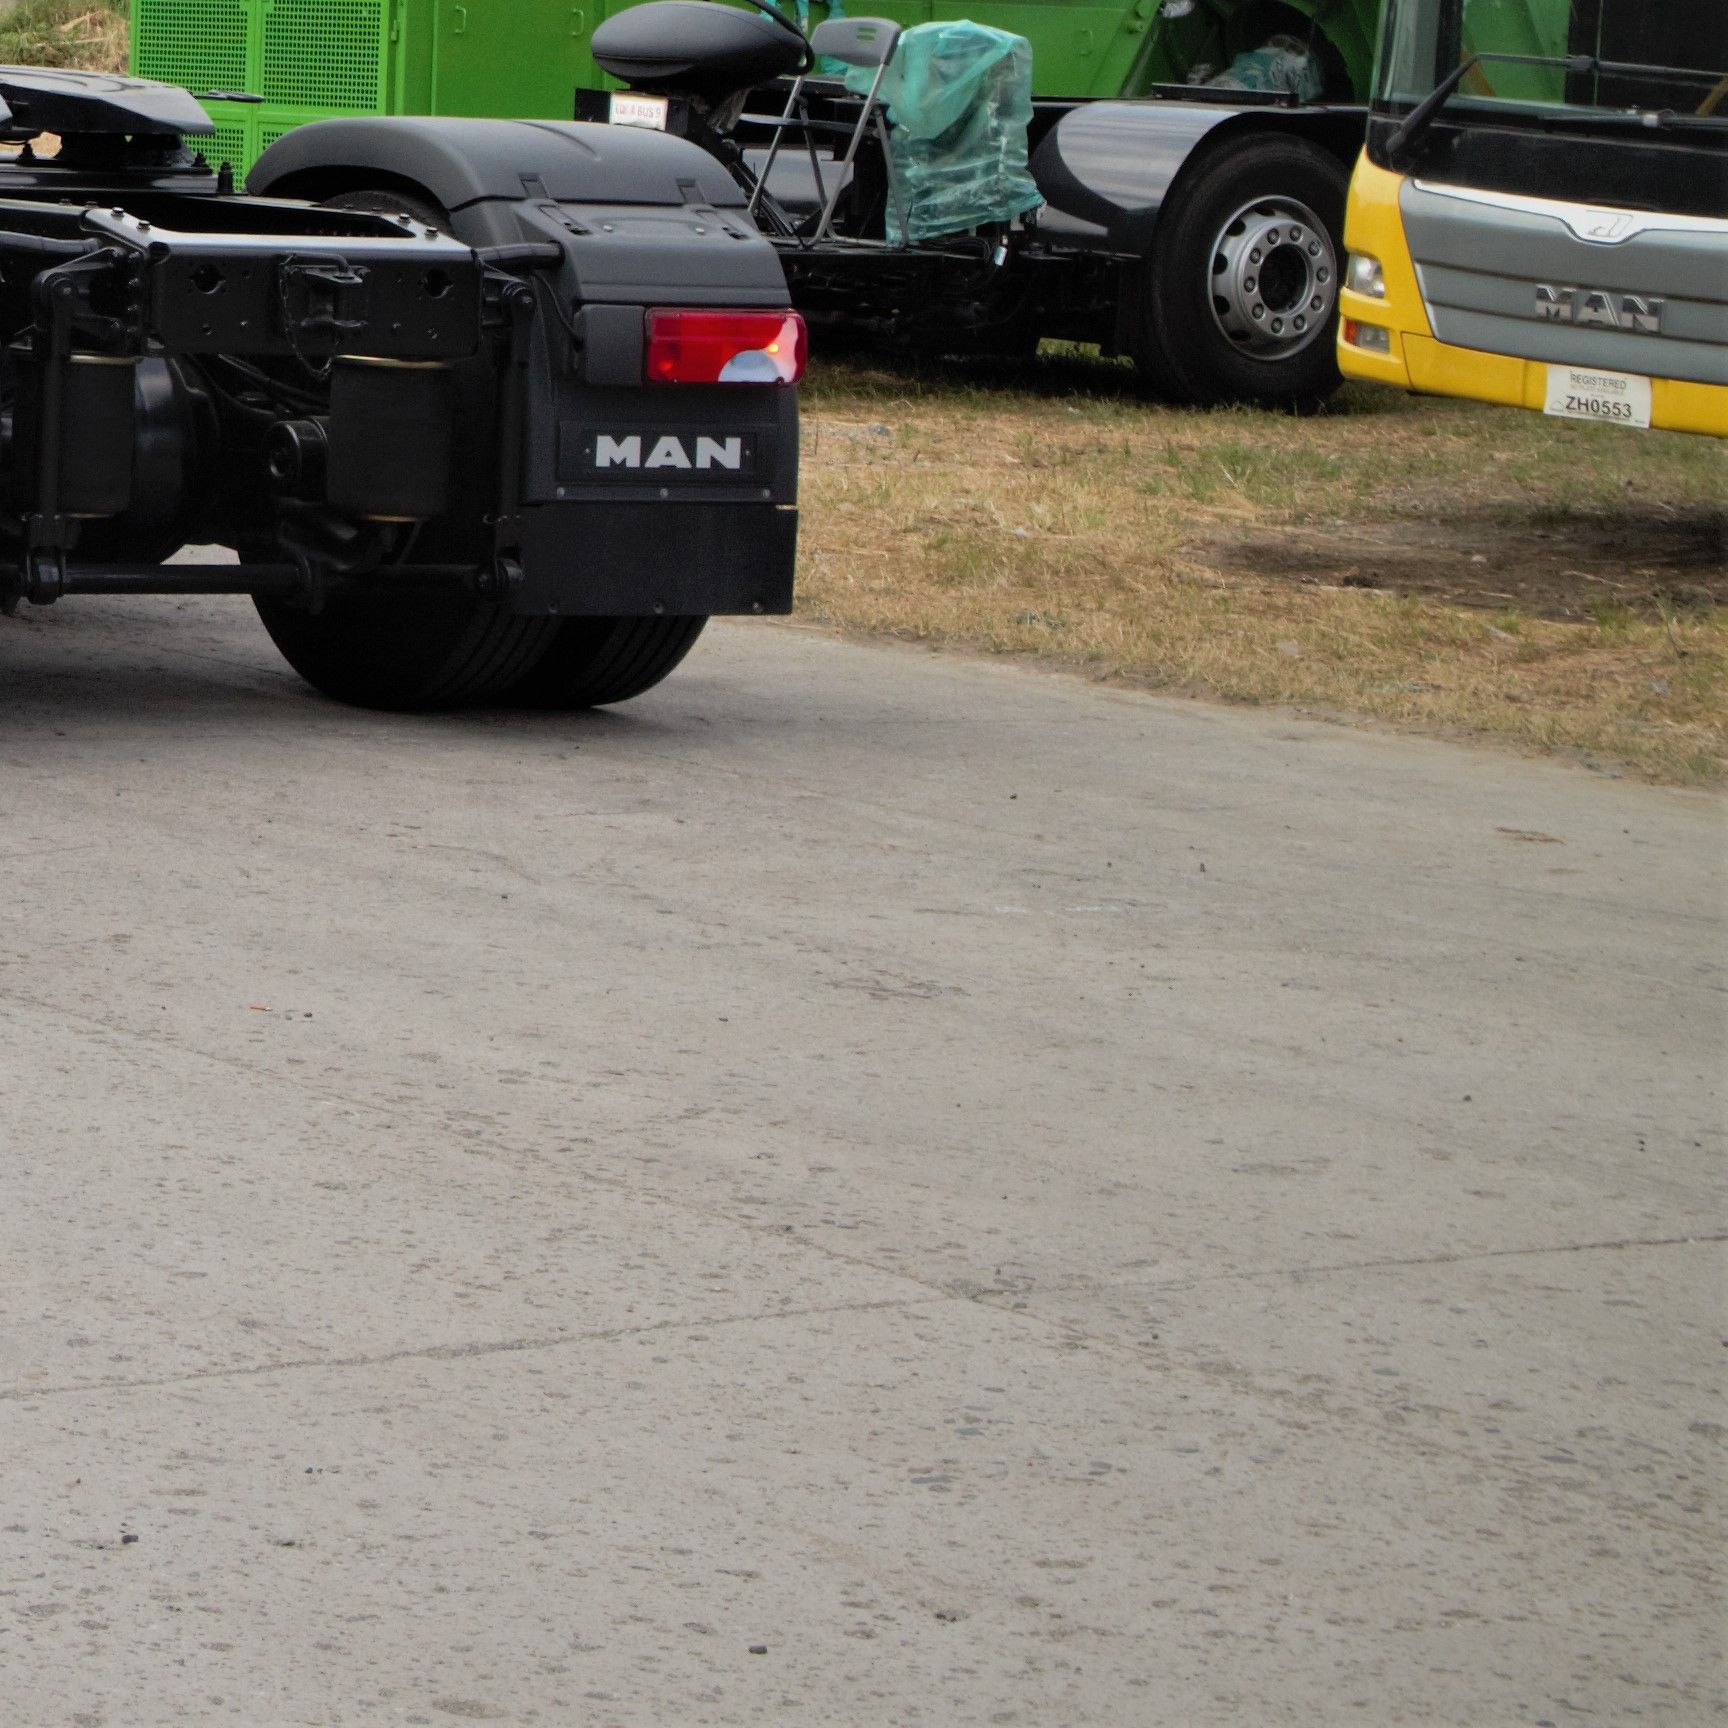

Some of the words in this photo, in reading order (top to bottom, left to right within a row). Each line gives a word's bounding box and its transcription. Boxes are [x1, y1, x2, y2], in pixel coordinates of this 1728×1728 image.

[1534, 283, 1665, 333] MAN
[1569, 373, 1628, 390] REGISTERED
[1565, 395, 1633, 418] ZH0553
[595, 435, 742, 469] MAN
